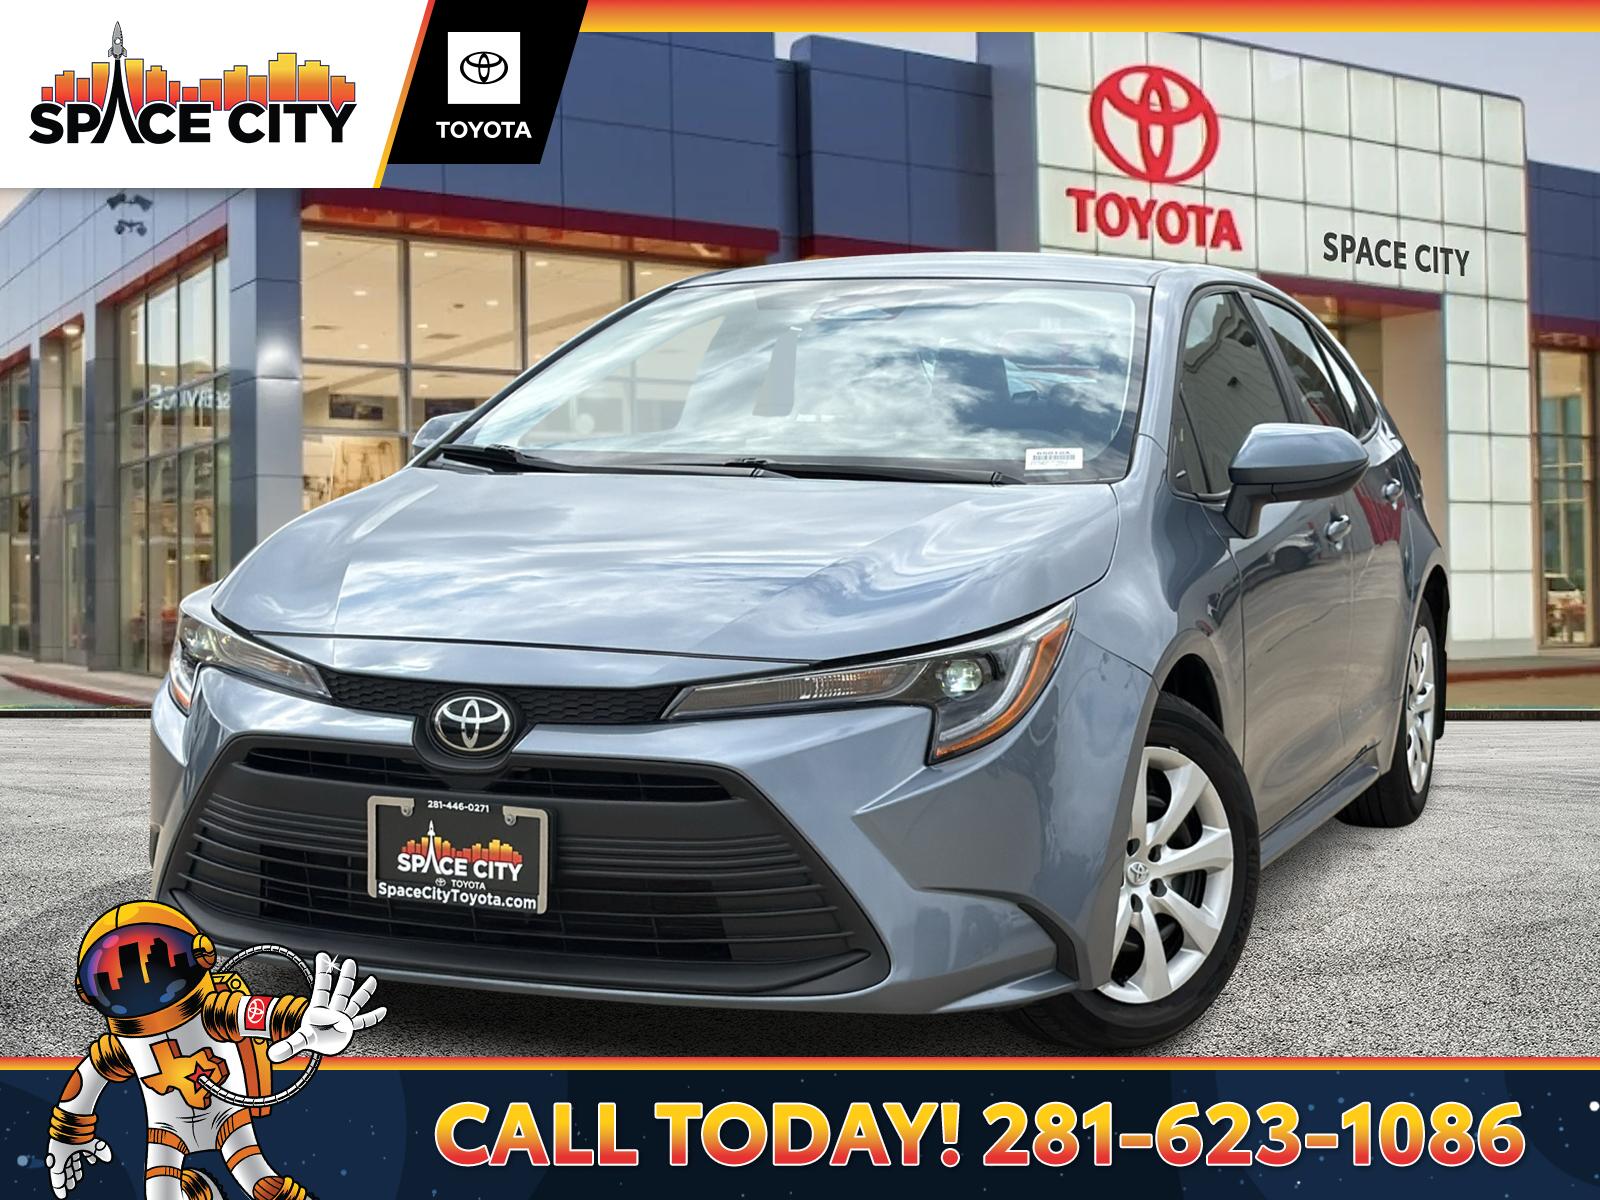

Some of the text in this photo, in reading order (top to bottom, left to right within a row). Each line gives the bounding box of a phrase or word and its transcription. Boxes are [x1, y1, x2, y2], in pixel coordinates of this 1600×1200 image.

[1066, 187, 1243, 251] TOYOTA
[1322, 231, 1470, 276] SPACE CITY
[427, 800, 490, 813] 281-446-0271
[397, 849, 523, 882] SPACE CITY
[378, 881, 537, 910] SpaceCityToyota.com
[451, 879, 486, 891] TOYOTA
